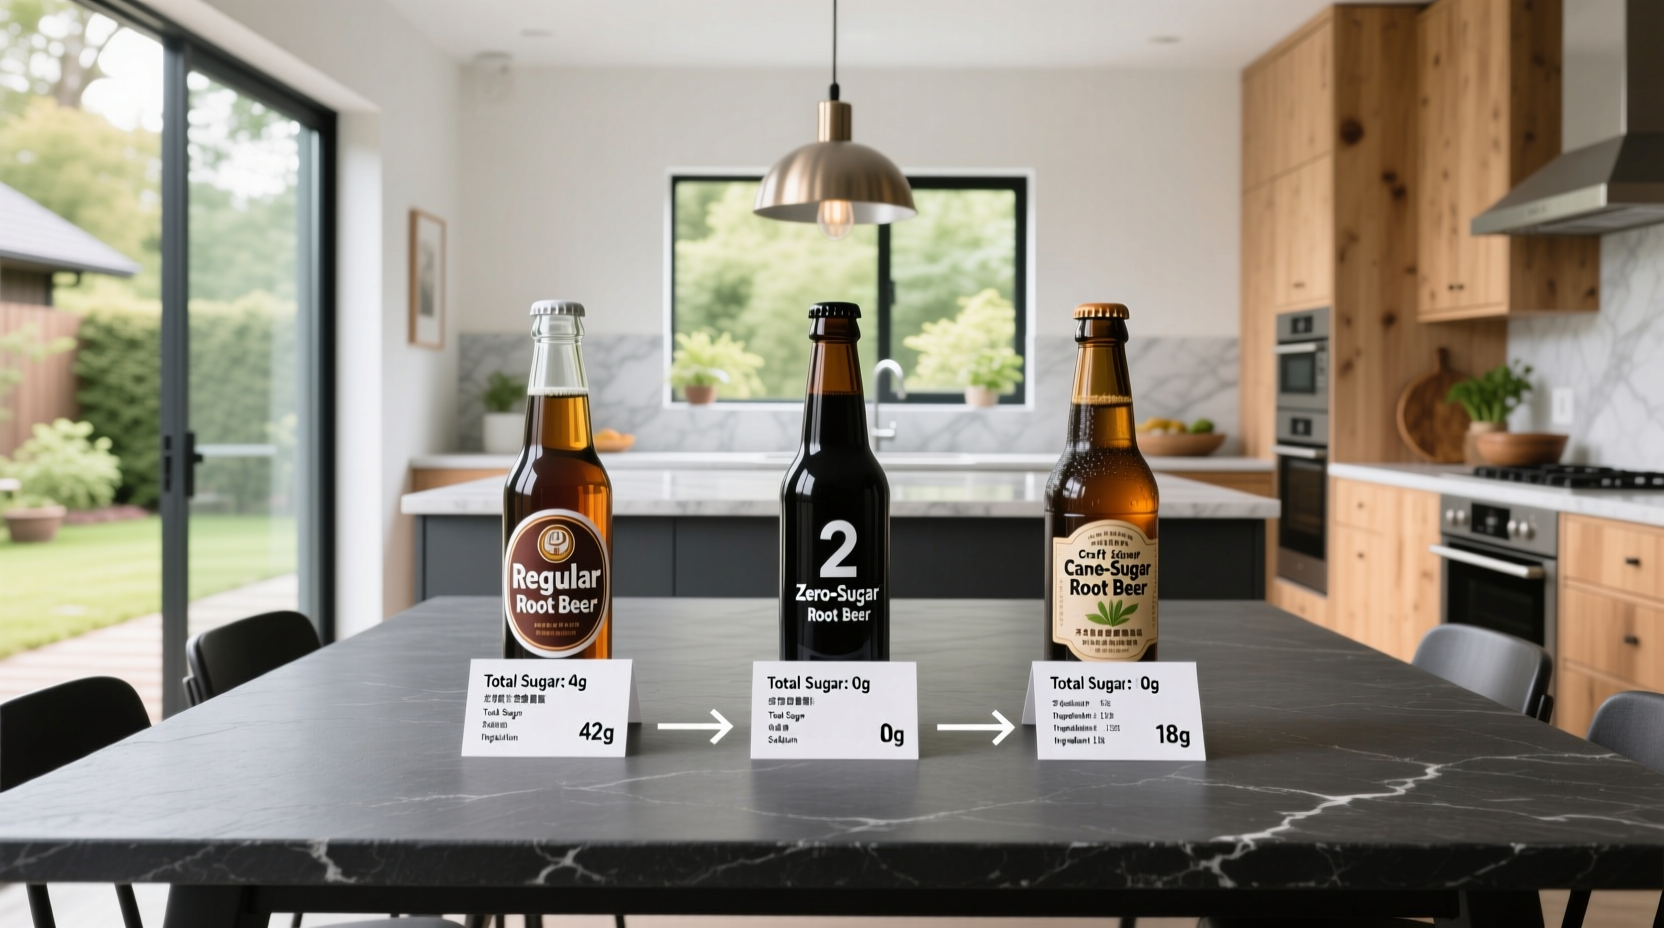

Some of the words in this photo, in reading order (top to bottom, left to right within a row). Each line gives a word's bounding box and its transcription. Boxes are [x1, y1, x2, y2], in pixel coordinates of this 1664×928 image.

[820, 519, 857, 578] 2
[513, 563, 601, 595] Regular
[1064, 560, 1151, 581] Cane-Sugar
[795, 584, 879, 606] Zero-Sugar
[1070, 579, 1108, 596] Root
[1113, 579, 1148, 596] Beer
[516, 595, 554, 613] Root
[559, 596, 598, 613] Beer
[808, 608, 838, 622] Root
[842, 608, 871, 621] Beer
[484, 674, 517, 687] Total
[521, 674, 565, 691] Sugar:
[569, 674, 587, 691] 4g
[768, 676, 800, 689] Total
[805, 676, 848, 693] Sugar:
[852, 676, 870, 693] 0g
[1050, 676, 1084, 690] Total
[1089, 677, 1132, 693] Sugar:
[1141, 676, 1159, 694] 0g
[579, 722, 614, 745] 42g
[881, 723, 904, 747] 0g
[1156, 724, 1190, 748] 18g
